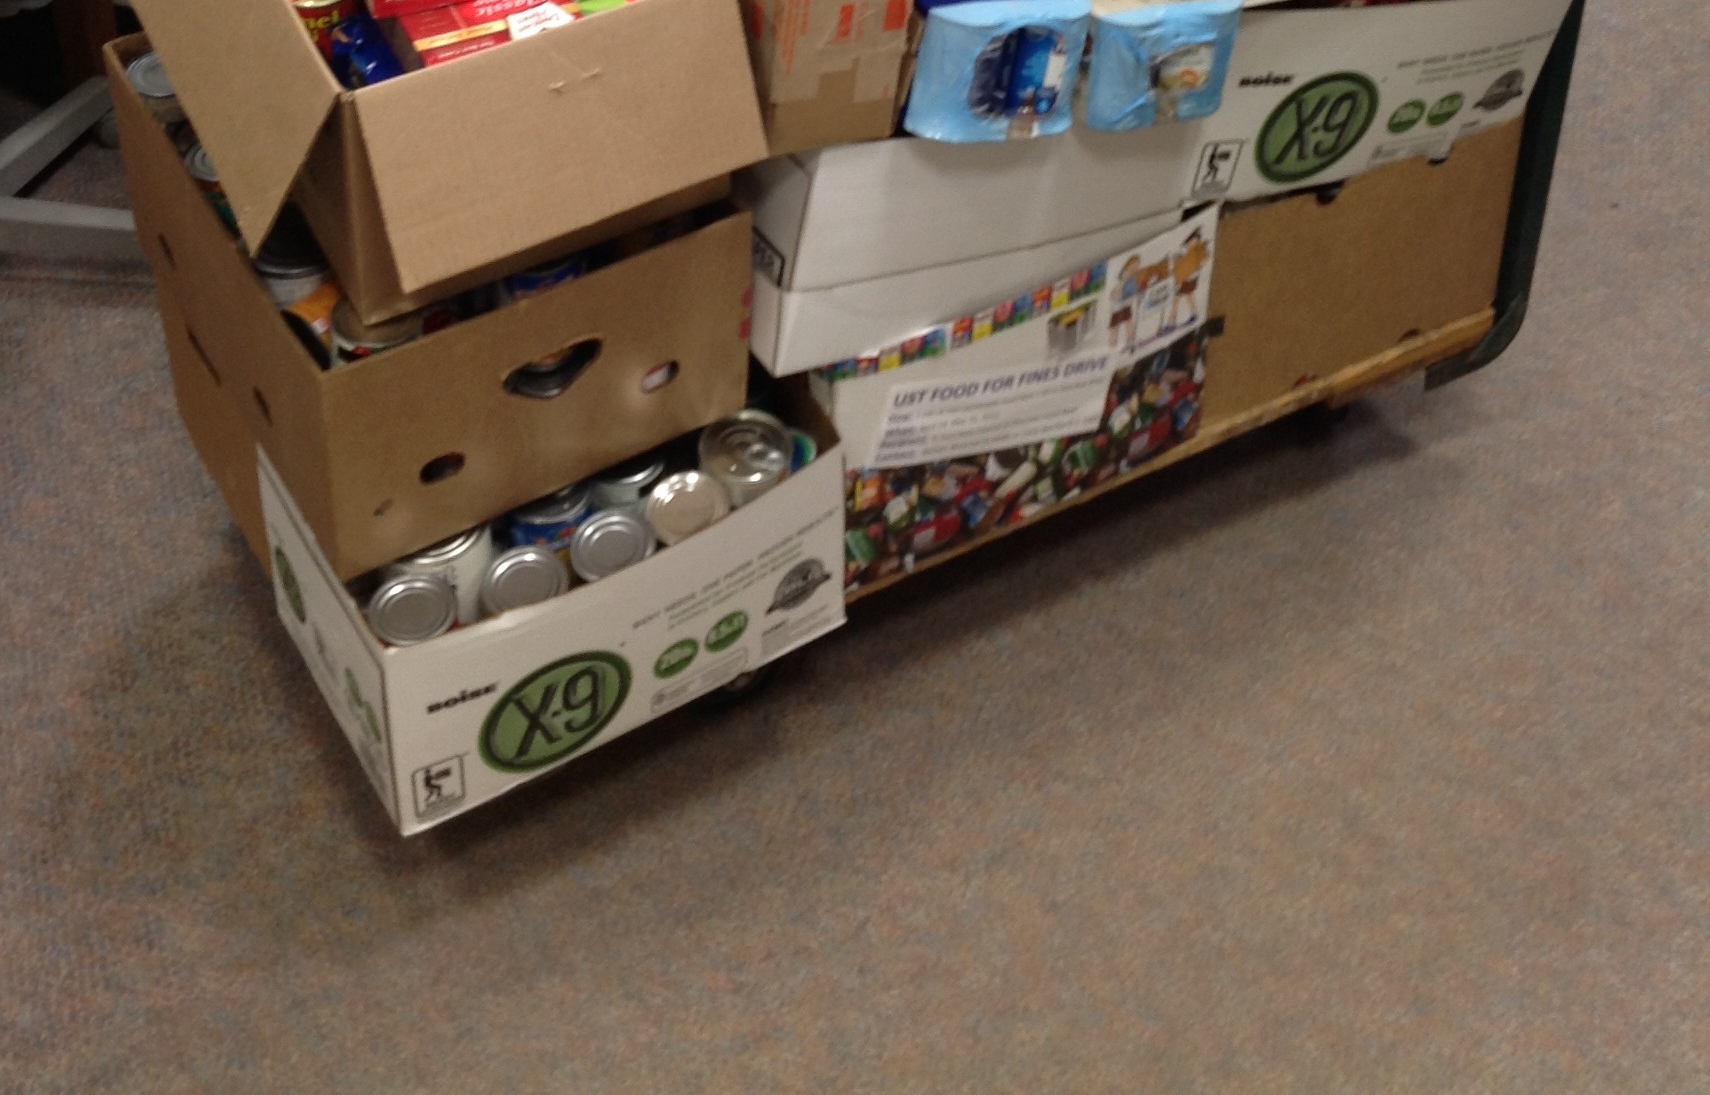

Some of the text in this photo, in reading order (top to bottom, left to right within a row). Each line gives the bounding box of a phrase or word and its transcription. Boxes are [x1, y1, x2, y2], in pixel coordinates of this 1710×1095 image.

[930, 383, 979, 403] FOOD
[982, 377, 1013, 395] FOR
[1017, 367, 1059, 387] FINES
[1062, 356, 1109, 379] DRIVE
